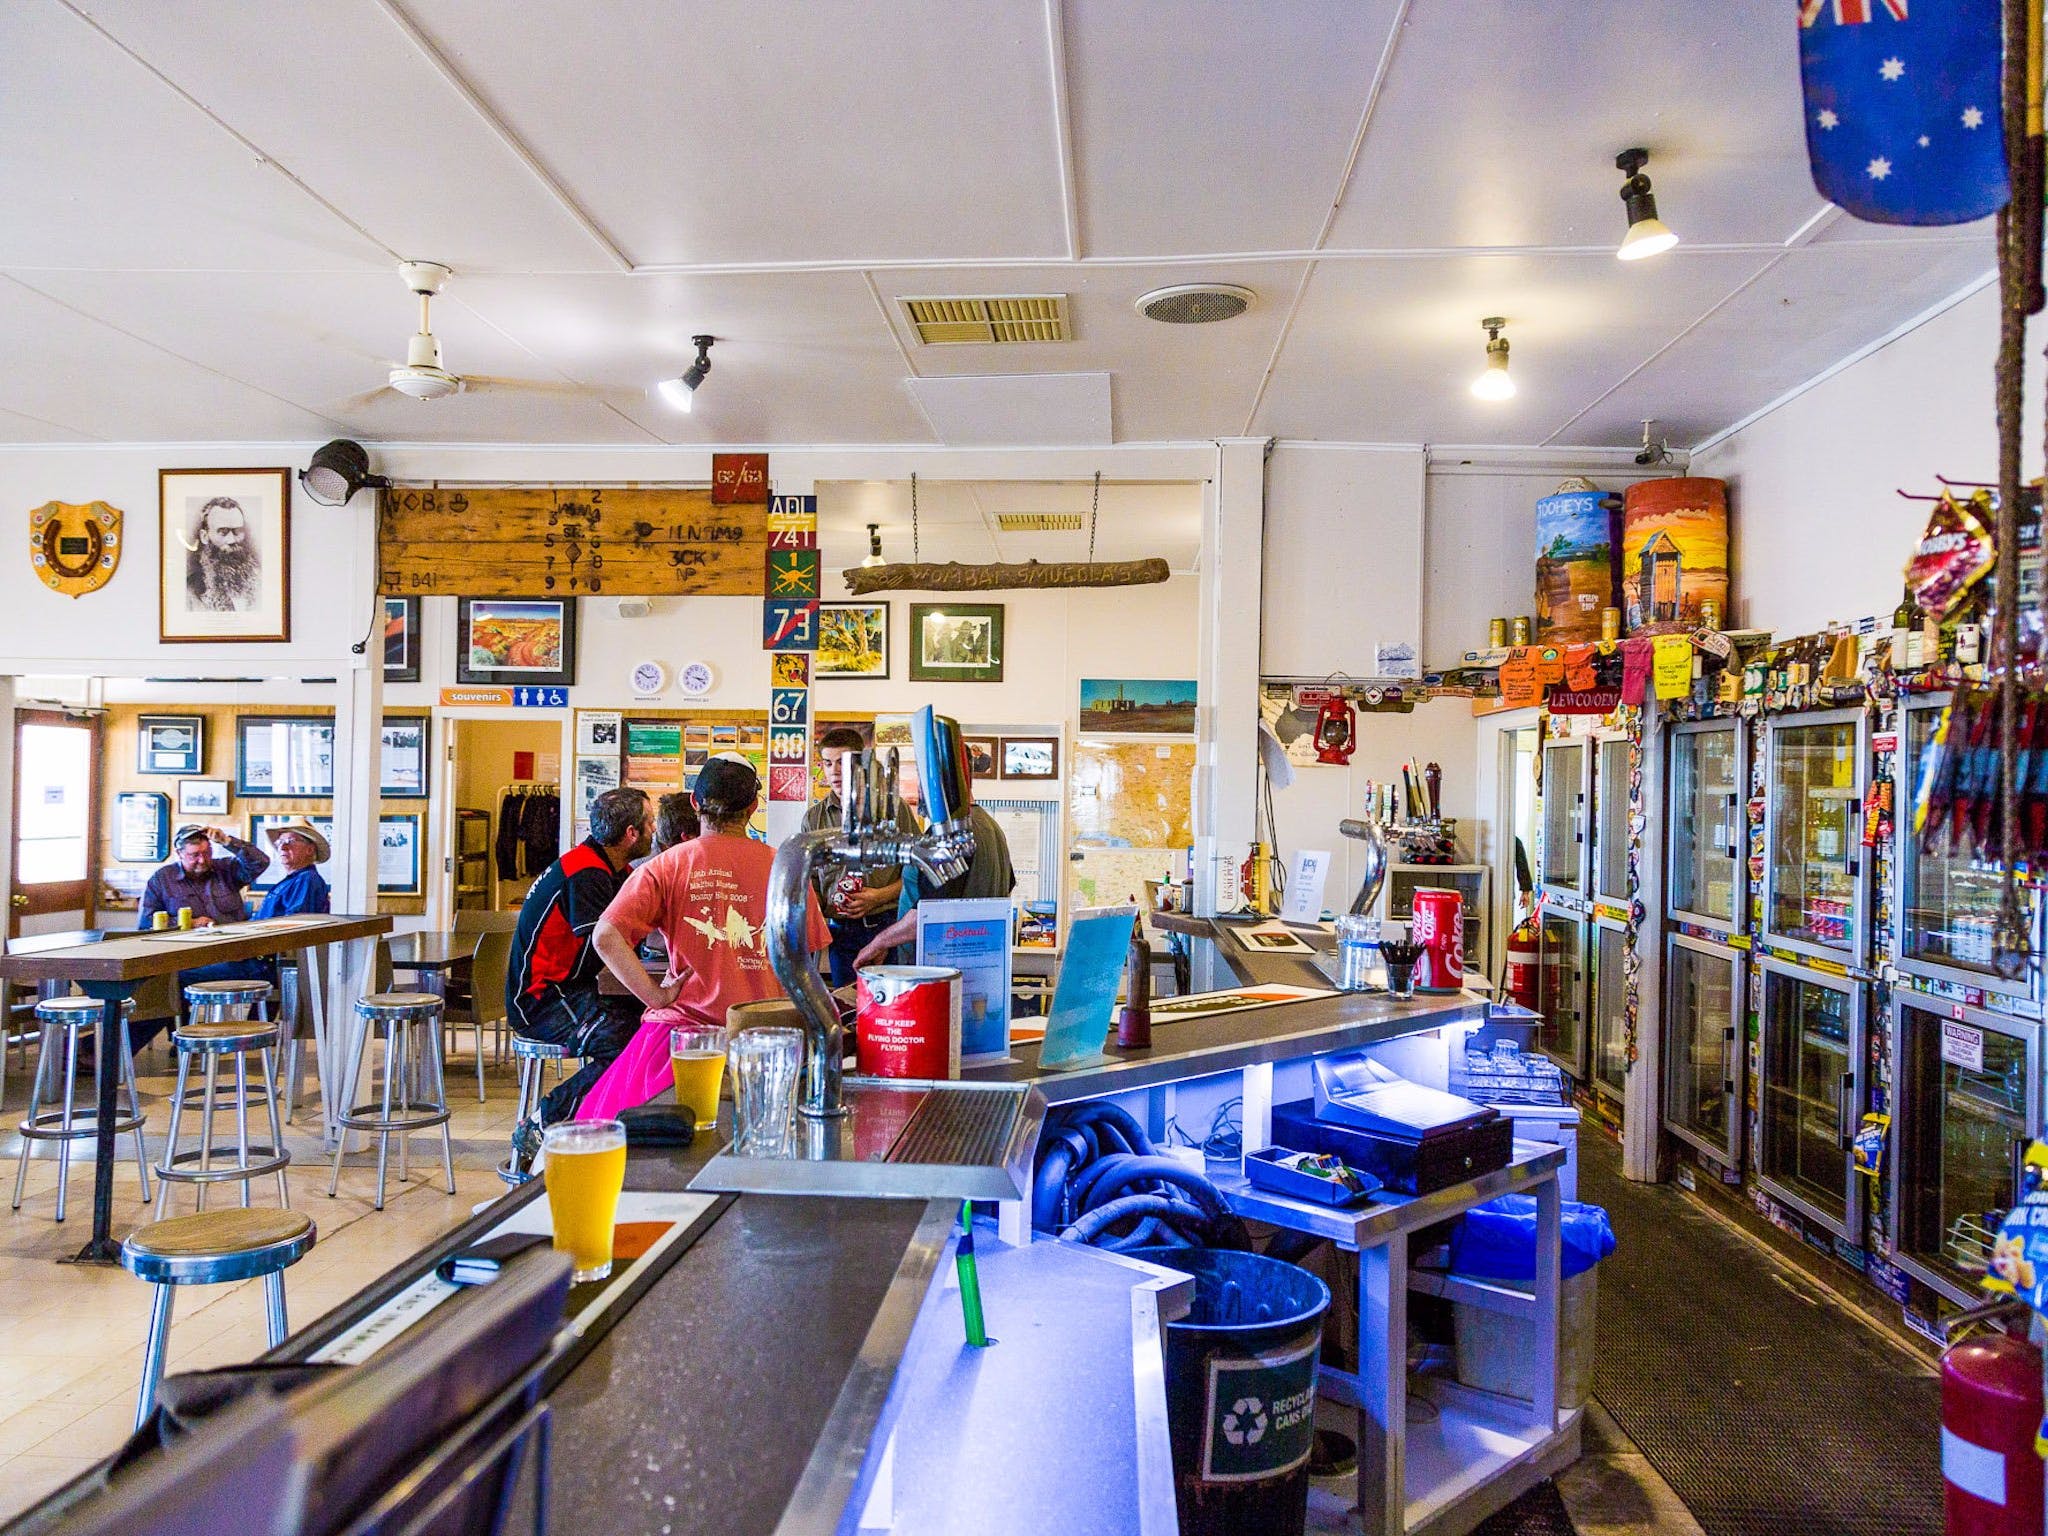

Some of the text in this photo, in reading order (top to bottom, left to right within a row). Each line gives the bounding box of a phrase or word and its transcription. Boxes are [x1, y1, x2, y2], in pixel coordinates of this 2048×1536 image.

[771, 496, 815, 520] ADL
[772, 524, 810, 548] 741
[790, 553, 798, 567] 1
[774, 608, 810, 642] 73
[451, 691, 502, 703] souvenirs
[773, 692, 805, 721] 67
[774, 732, 805, 760] 88
[875, 1018, 917, 1028] HELP KEEP
[887, 1027, 902, 1035] THE
[868, 1033, 925, 1044] FLYING DOCTOR
[1946, 1025, 1979, 1044] WARNING
[881, 1044, 908, 1052] FLYING
